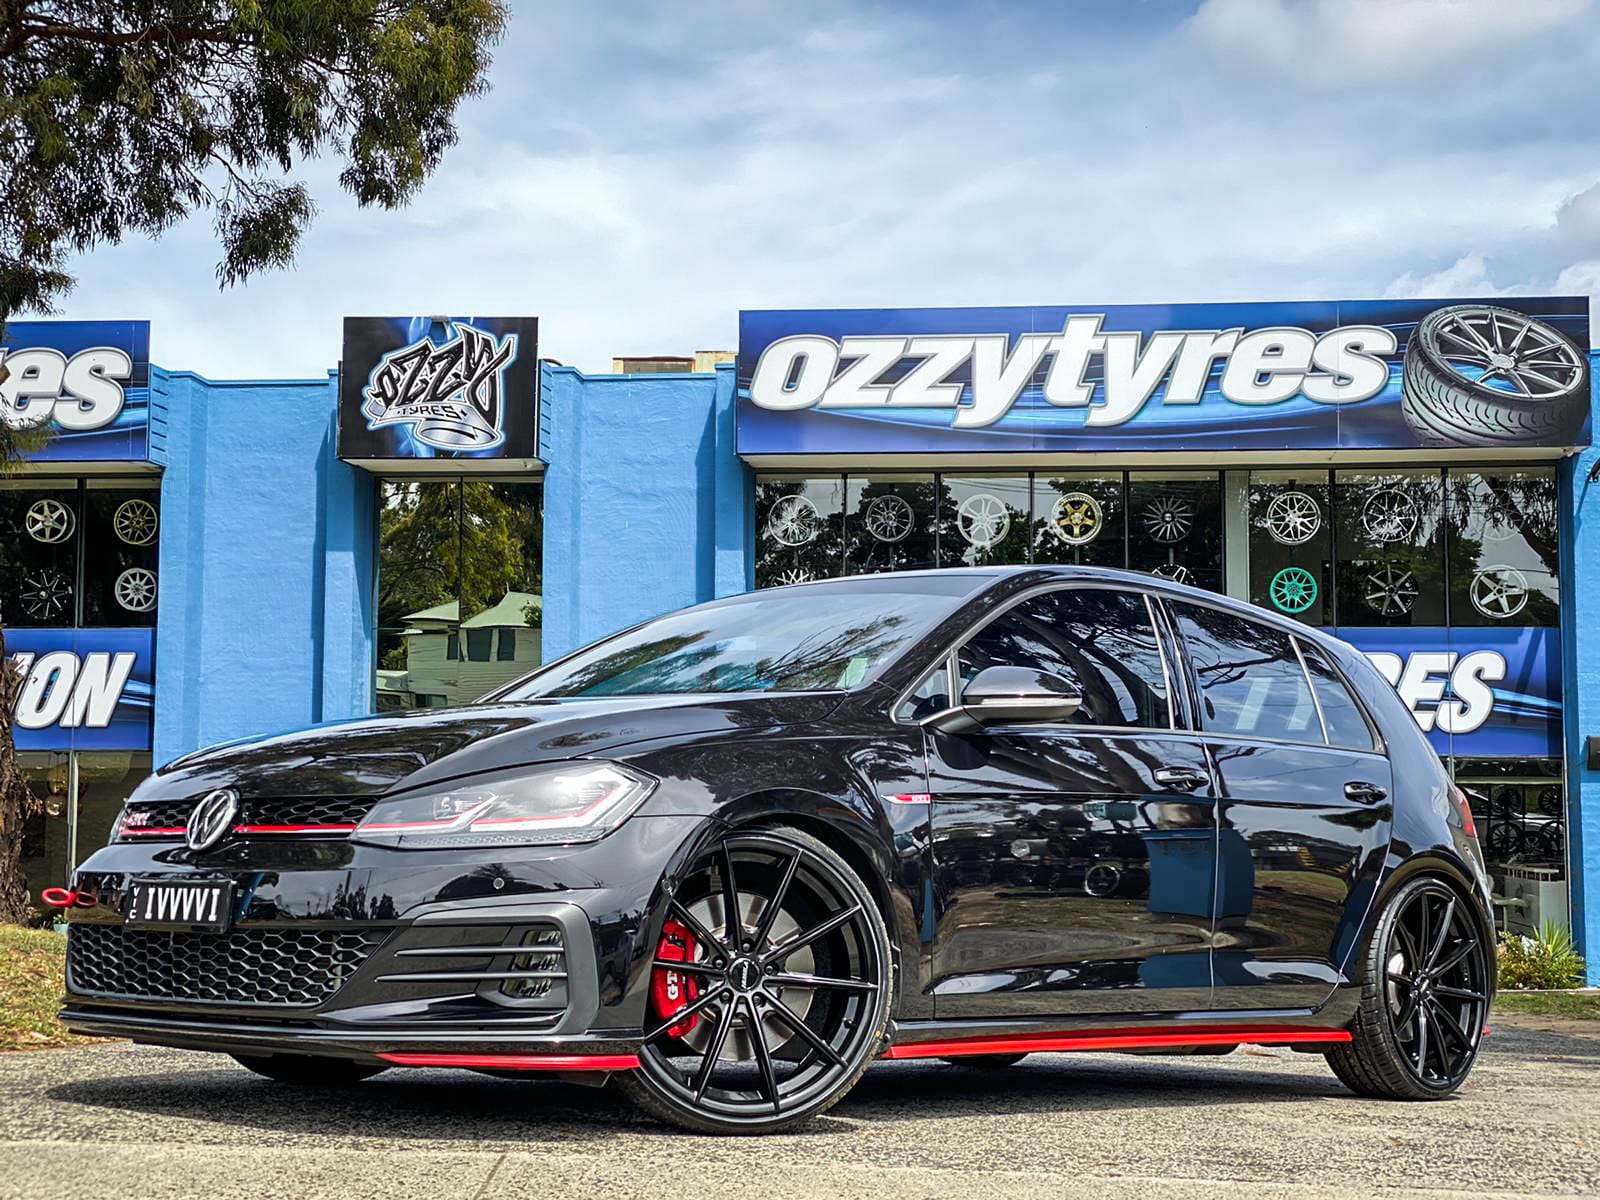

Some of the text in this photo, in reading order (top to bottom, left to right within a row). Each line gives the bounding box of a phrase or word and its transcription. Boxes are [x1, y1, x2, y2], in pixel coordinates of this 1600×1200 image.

[0, 346, 132, 430] es
[750, 313, 1398, 428] ozzytyres
[400, 404, 462, 421] TYRES
[1364, 651, 1506, 734] ES
